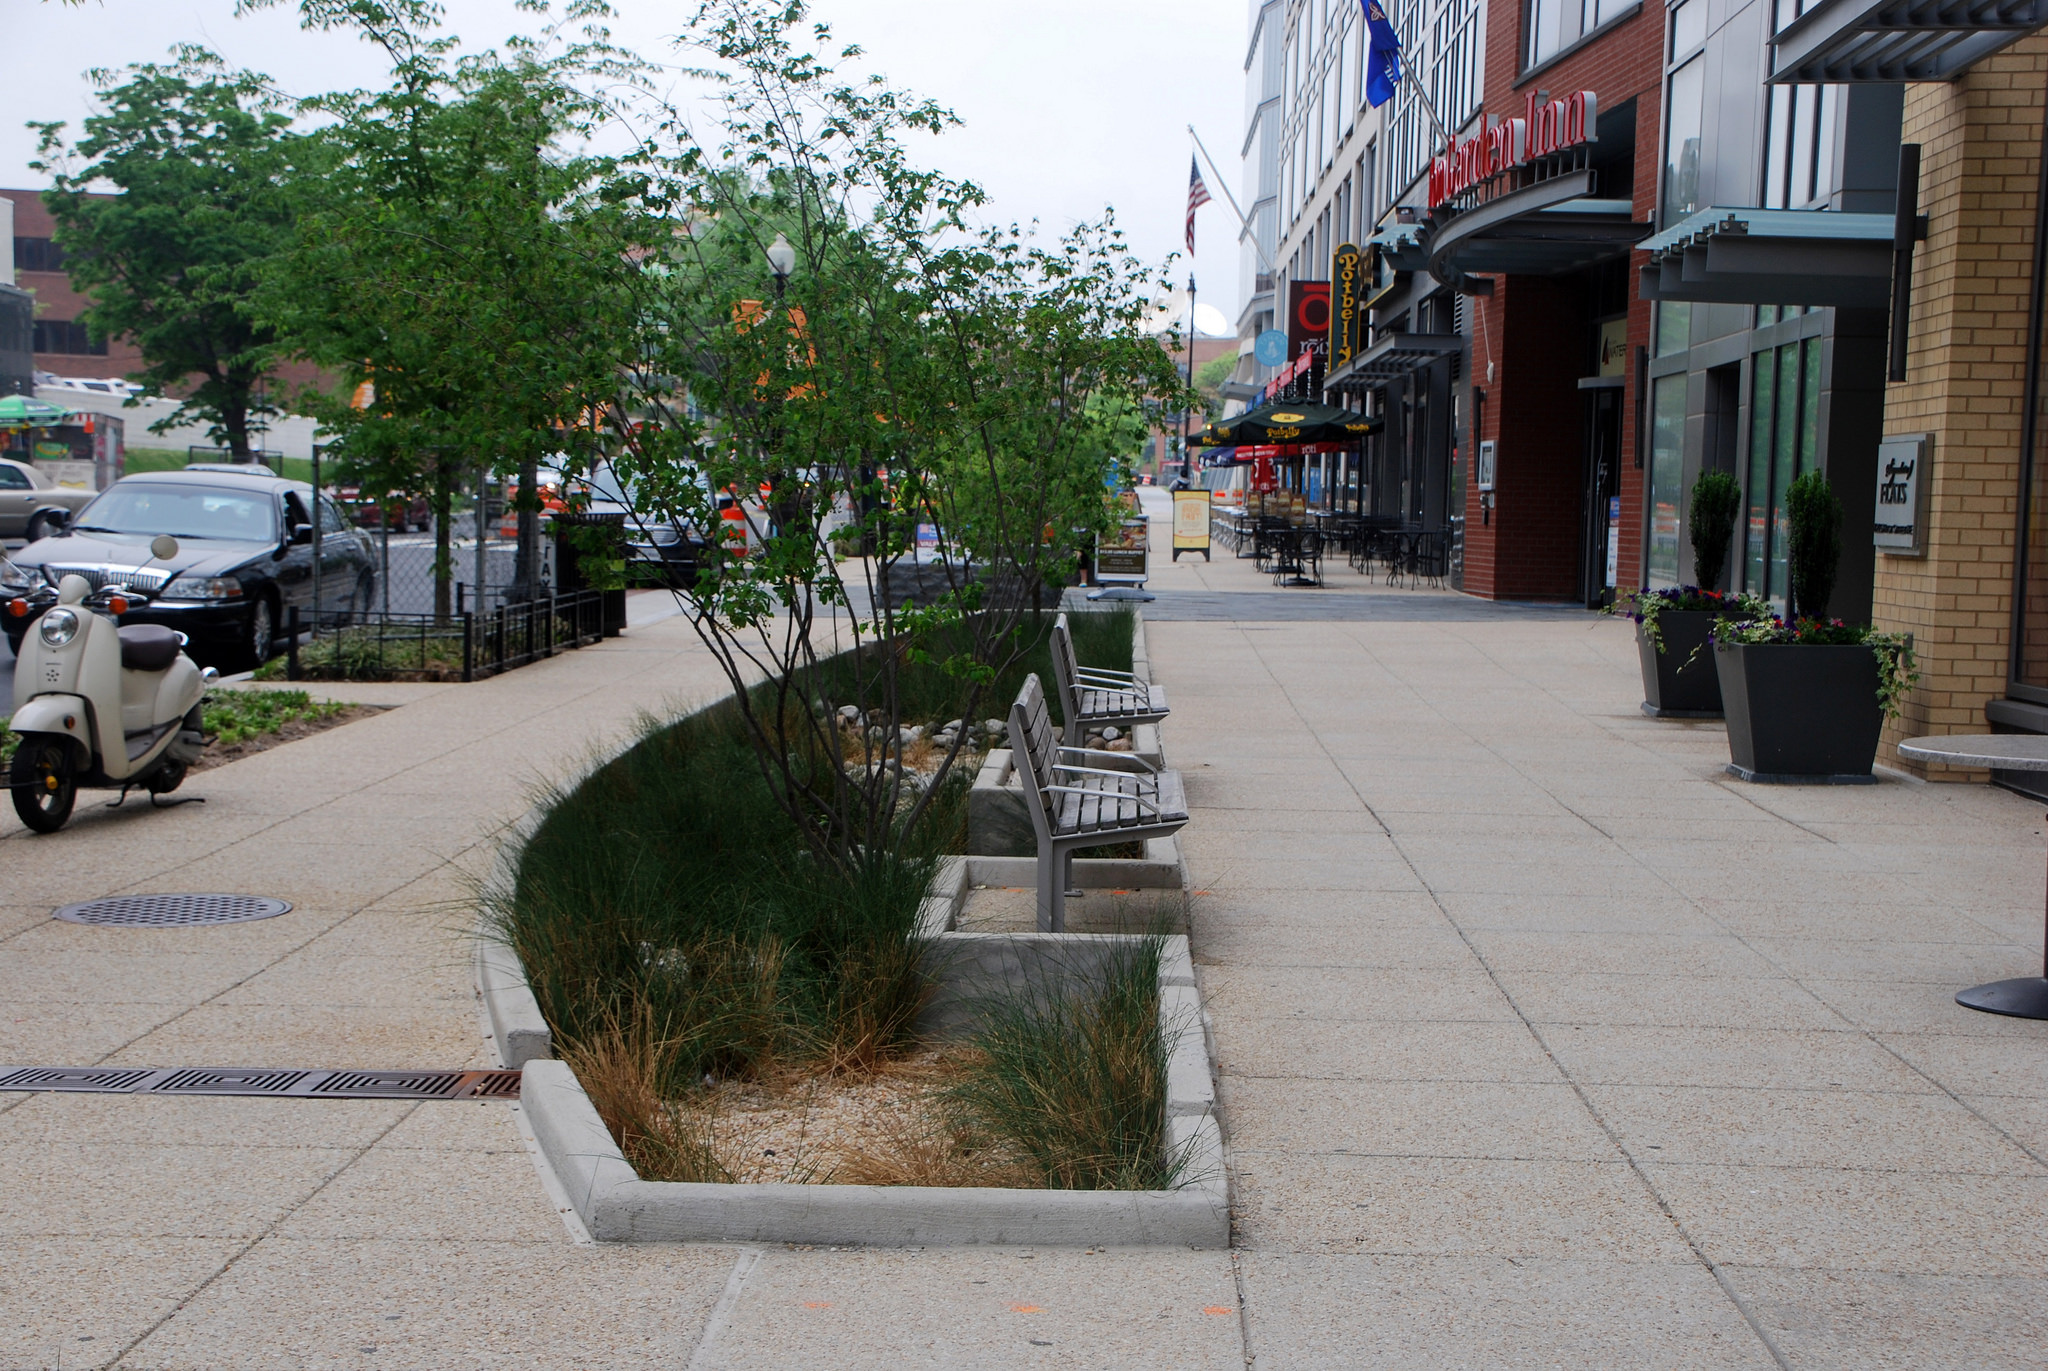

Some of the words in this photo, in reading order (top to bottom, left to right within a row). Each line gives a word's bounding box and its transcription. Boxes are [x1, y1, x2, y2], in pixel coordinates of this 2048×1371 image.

[1446, 114, 1523, 196] Garden
[1522, 89, 1595, 162] Inn
[1337, 253, 1358, 367] Potbelly
[1879, 483, 1907, 504] FLATS
